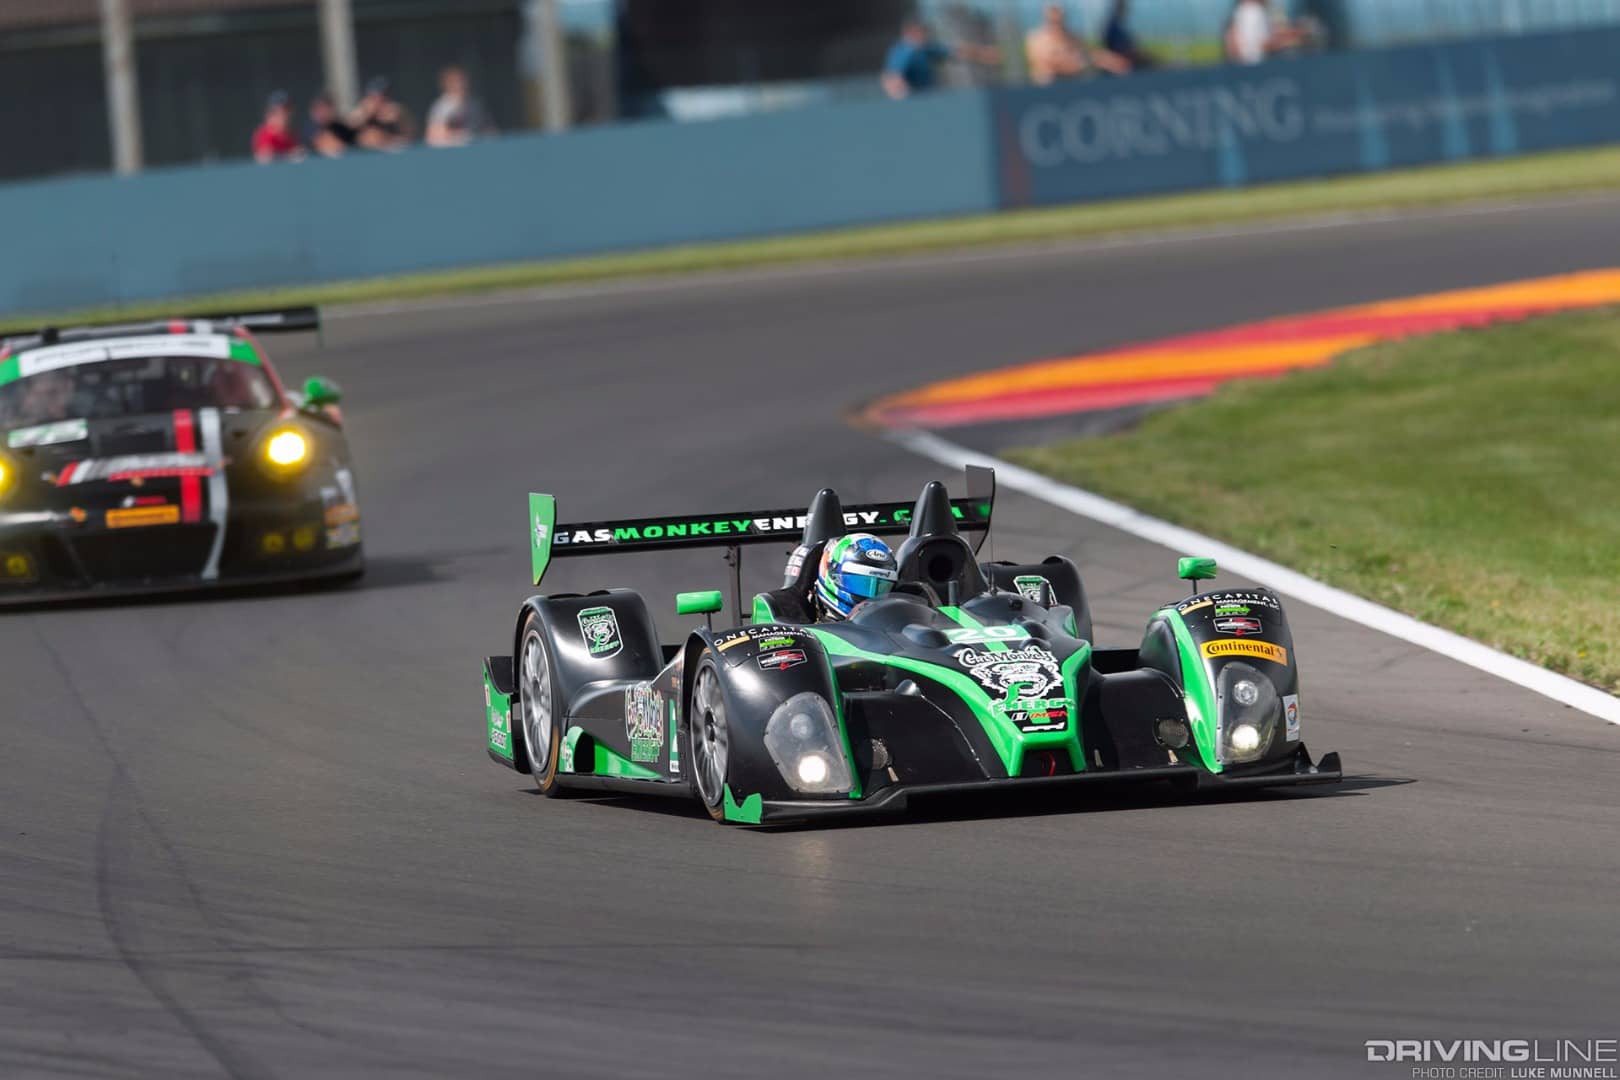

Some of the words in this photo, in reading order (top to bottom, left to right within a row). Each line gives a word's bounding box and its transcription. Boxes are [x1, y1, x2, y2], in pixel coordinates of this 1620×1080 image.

[1019, 78, 1304, 167] CORNING
[953, 627, 1017, 640] 20
[1206, 641, 1274, 656] Continental
